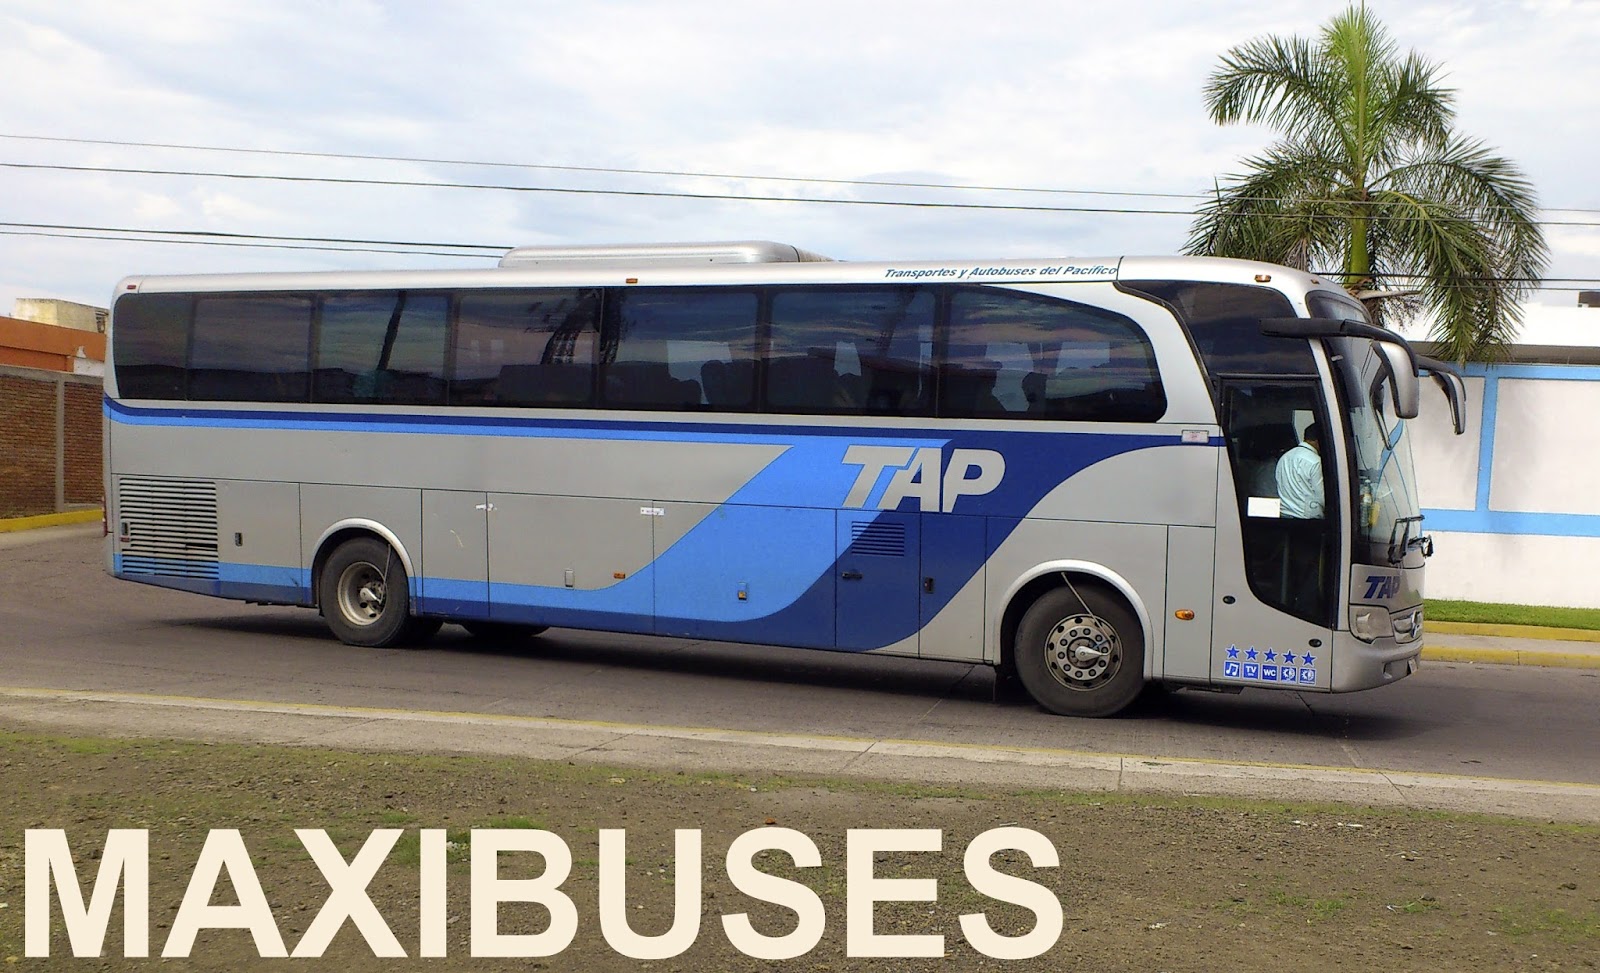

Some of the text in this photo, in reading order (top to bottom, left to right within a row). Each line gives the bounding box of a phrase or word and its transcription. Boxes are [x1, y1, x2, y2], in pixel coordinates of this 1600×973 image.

[885, 268, 957, 279] Transportes
[969, 266, 1037, 276] Autobuses
[1039, 266, 1062, 275] del
[842, 445, 1006, 513] TAP
[1363, 575, 1400, 599] TAP
[1245, 665, 1257, 674] TV
[1263, 669, 1276, 677] WC
